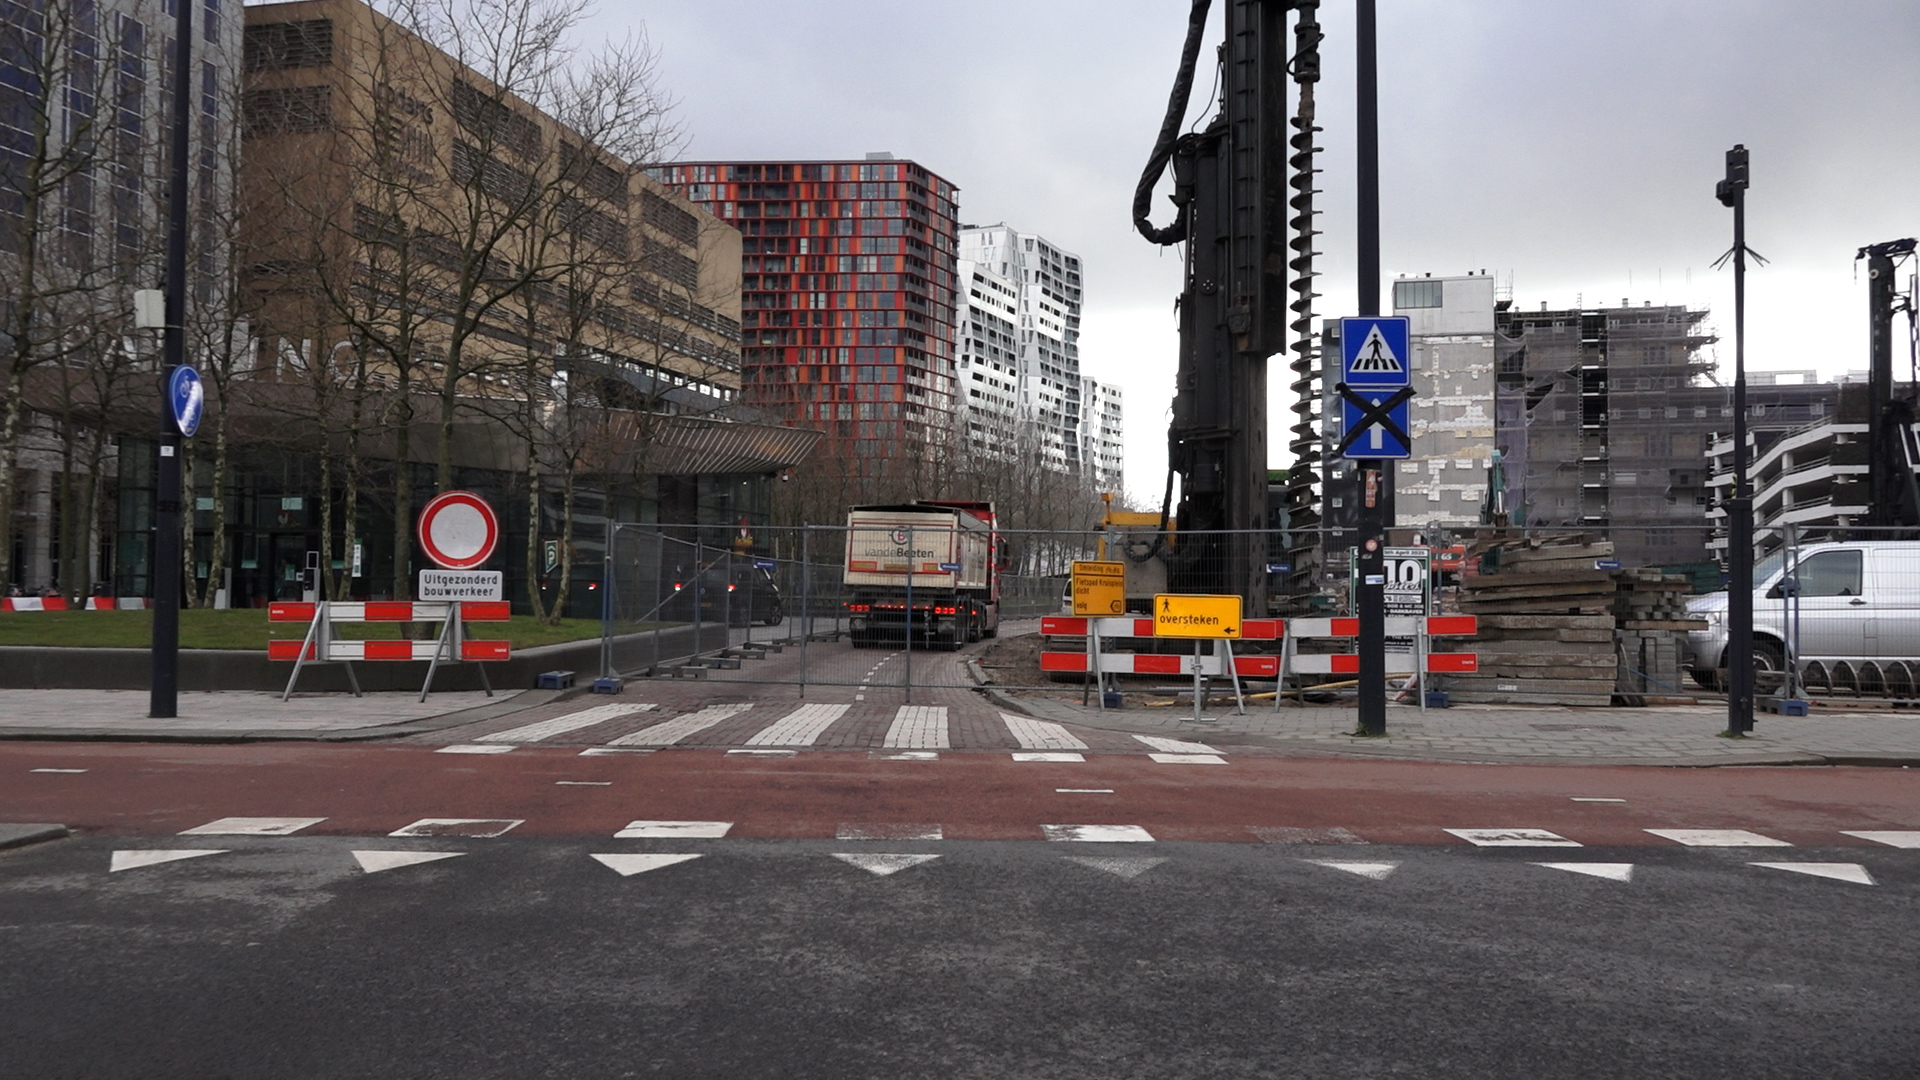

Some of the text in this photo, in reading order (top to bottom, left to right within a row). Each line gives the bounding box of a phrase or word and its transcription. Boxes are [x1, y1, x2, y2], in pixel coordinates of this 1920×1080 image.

[424, 574, 498, 587] Uitgezonderd
[1076, 578, 1098, 587] Fietspad
[424, 586, 494, 596] bouwverkeer
[1076, 587, 1090, 595] dicht
[1076, 601, 1088, 611] volg
[1160, 614, 1219, 625] oversteken
